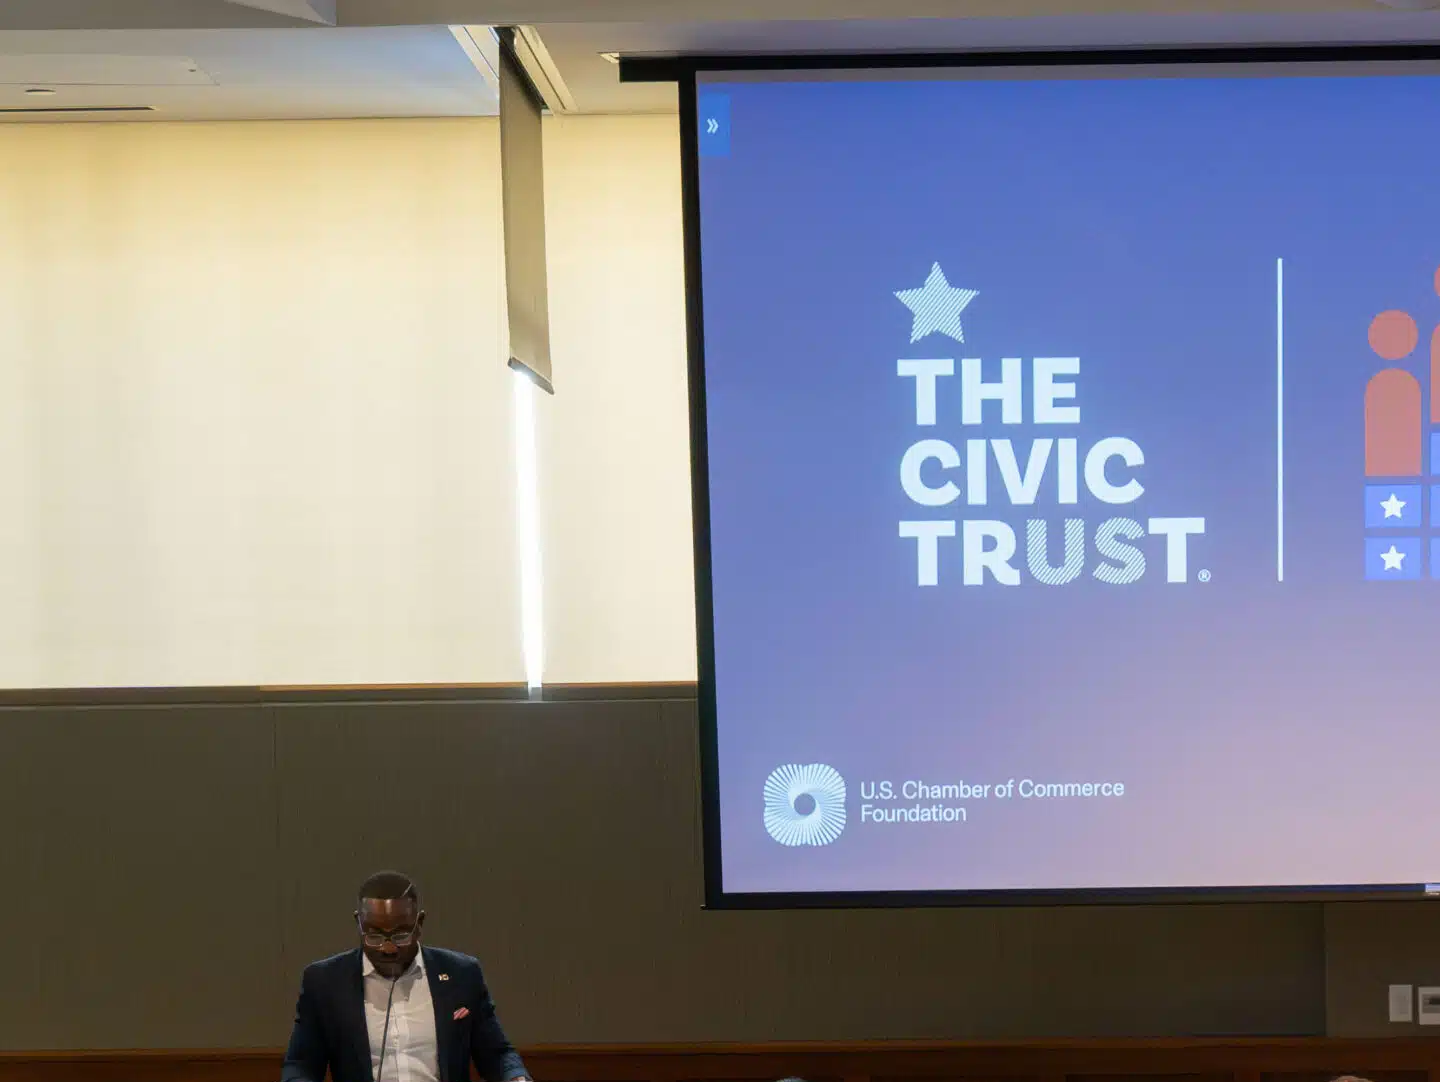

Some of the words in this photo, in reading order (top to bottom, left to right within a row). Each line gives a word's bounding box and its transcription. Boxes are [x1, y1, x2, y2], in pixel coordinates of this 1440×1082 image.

[897, 357, 1080, 425] THE
[900, 436, 1145, 506] CIVIC
[860, 781, 897, 800] U.S.
[902, 780, 990, 799] Chamber
[994, 779, 1014, 798] of
[1018, 779, 1125, 798] Commerce
[860, 804, 967, 823] Foundation
